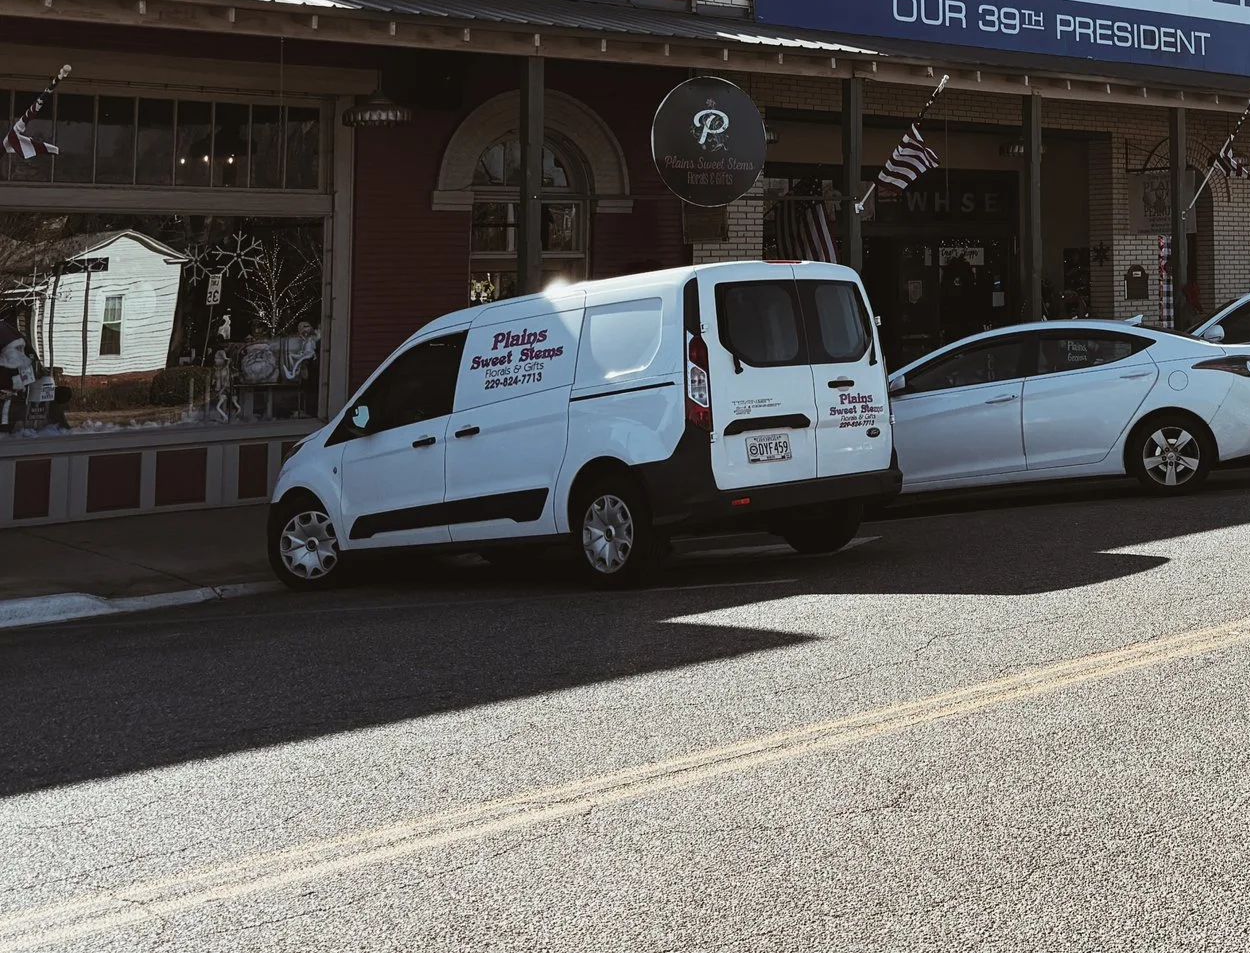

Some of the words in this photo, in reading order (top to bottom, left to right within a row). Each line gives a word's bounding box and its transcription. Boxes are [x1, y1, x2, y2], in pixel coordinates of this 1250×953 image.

[978, 4, 1045, 33] 39TH
[1056, 15, 1210, 56] PRESIDENT
[693, 109, 729, 145] P
[664, 155, 694, 169] Plains
[697, 156, 724, 170] Sweet
[727, 157, 753, 171] Stems
[491, 328, 548, 350] Plains
[470, 350, 513, 370] Sweet
[518, 345, 564, 363] Stems
[485, 368, 511, 379] Florals
[513, 365, 521, 374] &
[524, 362, 544, 372] Gifts
[485, 372, 542, 390] 229-824-7713
[839, 392, 873, 405] Plains
[830, 405, 857, 416] Sweet
[861, 404, 883, 414] Stems
[758, 441, 788, 455] DYF459
